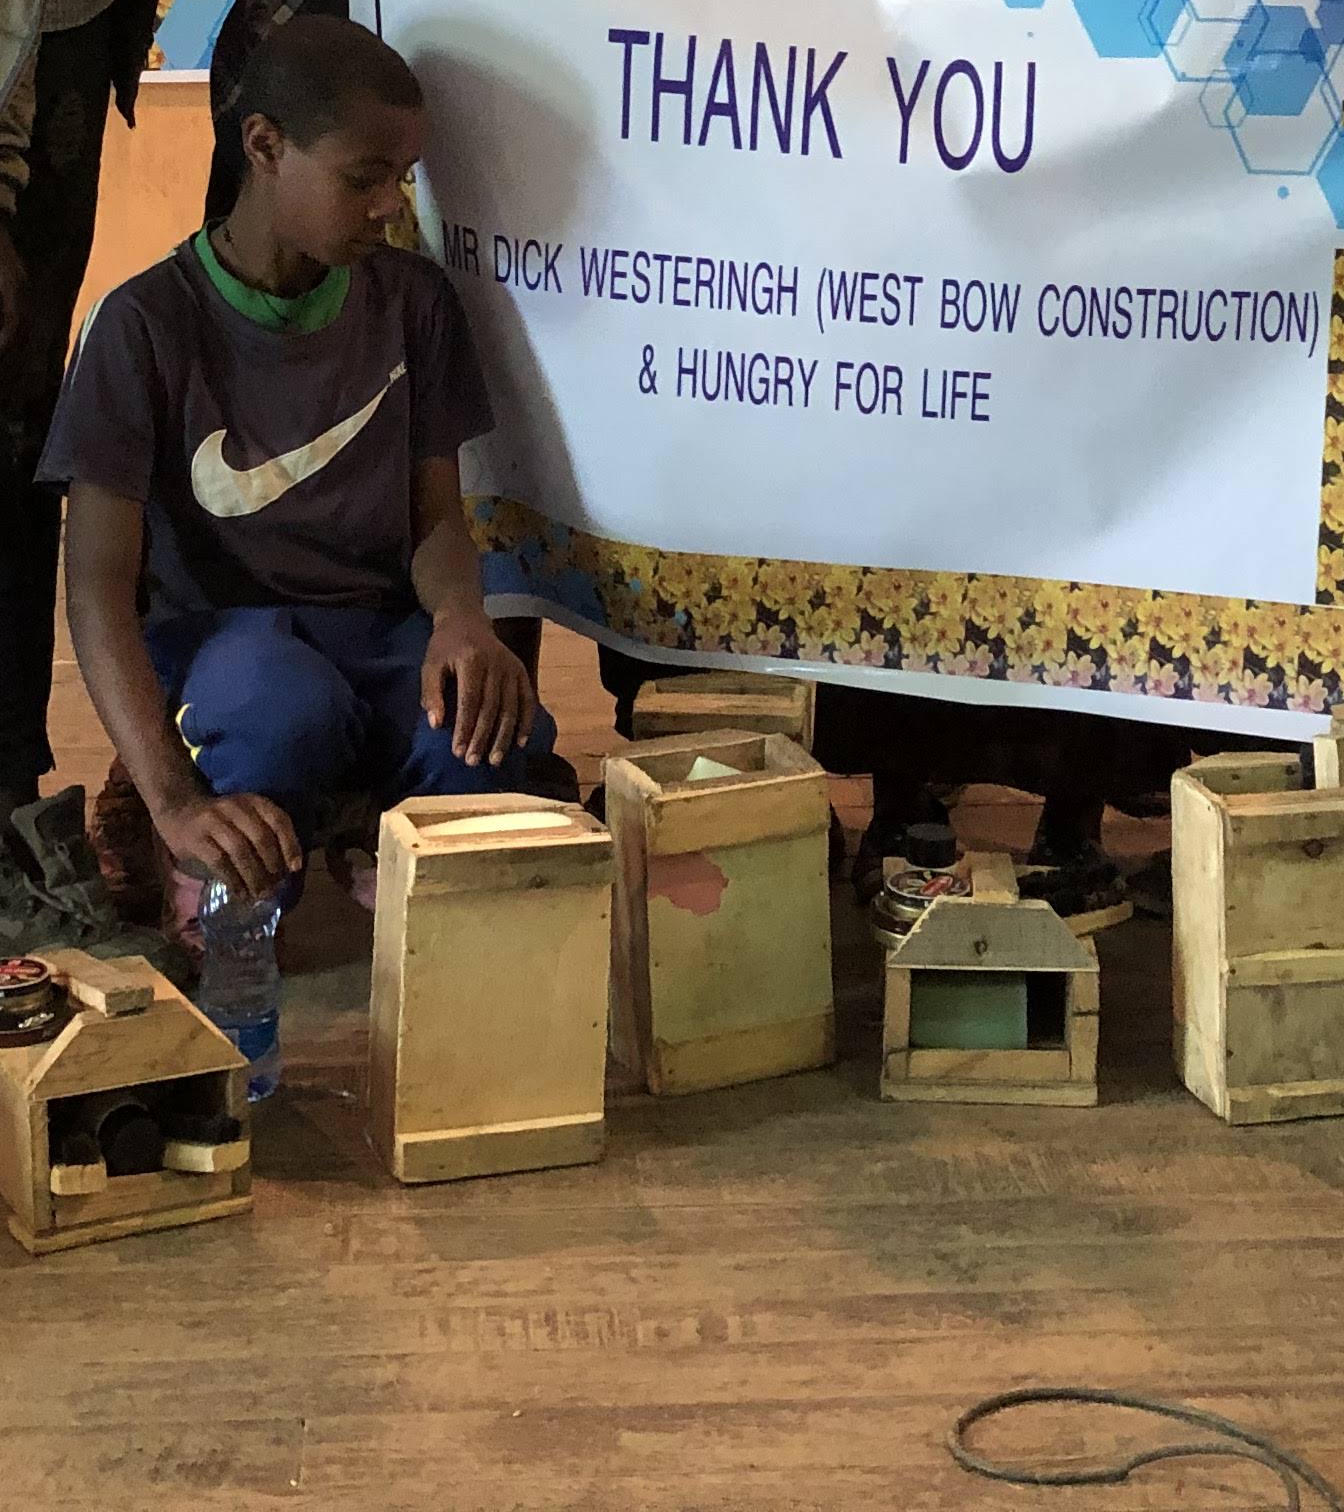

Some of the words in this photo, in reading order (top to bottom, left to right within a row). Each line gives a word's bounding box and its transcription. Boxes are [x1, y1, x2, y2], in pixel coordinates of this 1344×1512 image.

[607, 28, 849, 159] THANK
[885, 56, 1036, 174] YOU
[441, 219, 481, 276] MR
[493, 235, 564, 294] DICK
[579, 246, 799, 317] WESTERINGH
[816, 267, 924, 335] (WEST
[940, 278, 1023, 334] BOW
[1037, 283, 1320, 358] CONSTRUCTION)
[638, 343, 660, 395] &
[676, 346, 820, 409] HUNGRY
[834, 360, 904, 416] FOR
[921, 368, 993, 422] LIFE
